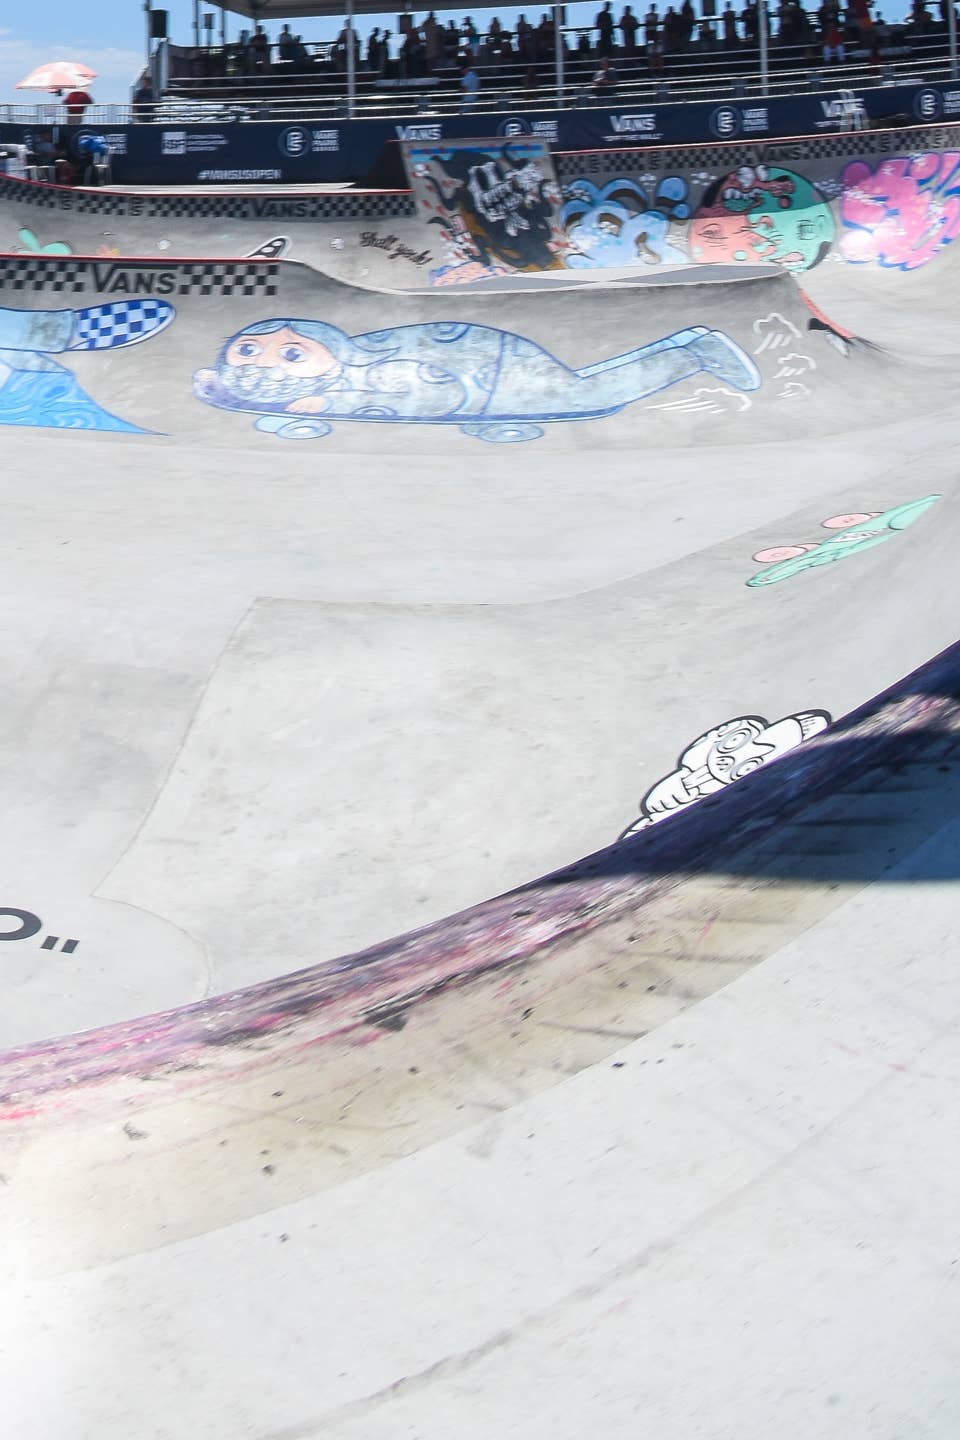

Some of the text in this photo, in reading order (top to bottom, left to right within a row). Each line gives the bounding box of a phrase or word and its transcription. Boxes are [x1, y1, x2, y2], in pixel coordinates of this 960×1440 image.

[395, 124, 442, 140] VANS
[610, 114, 656, 132] VANS
[251, 197, 312, 218] VANS
[91, 263, 178, 295] VANS
